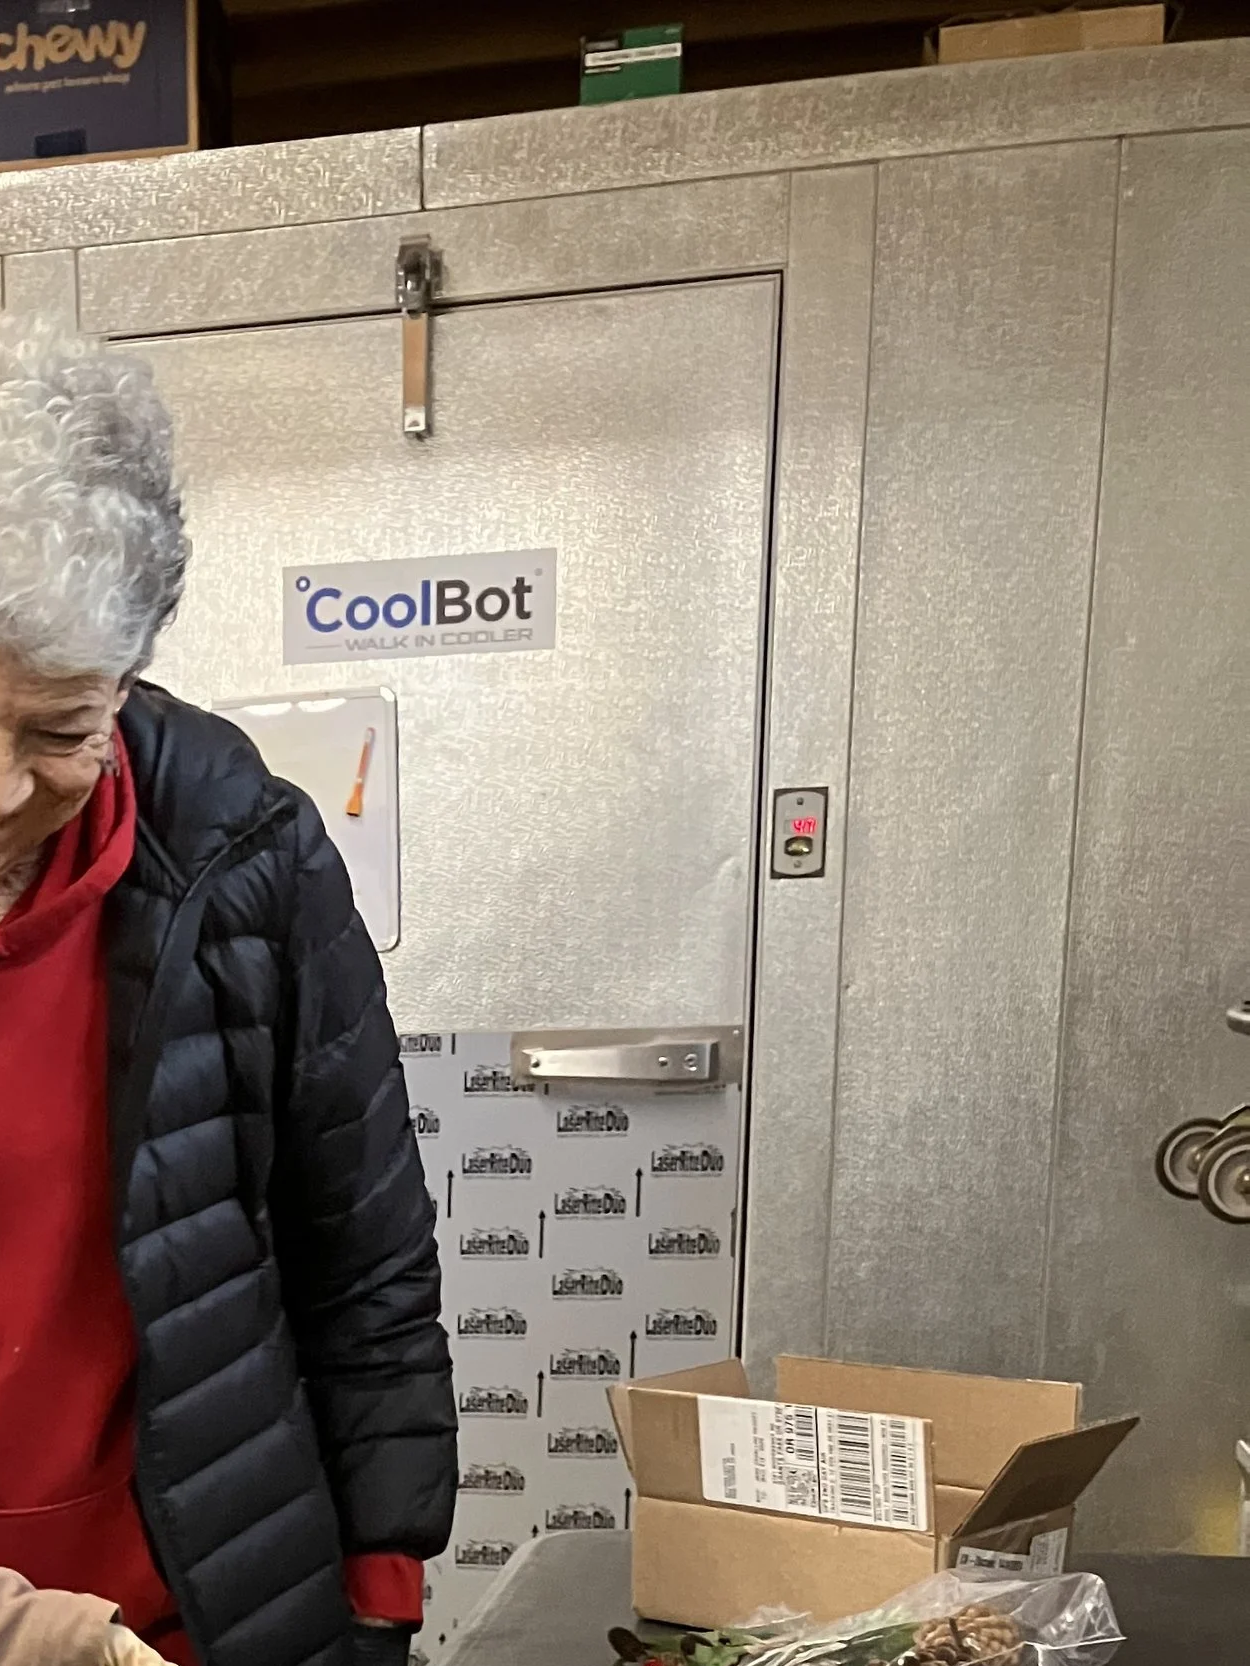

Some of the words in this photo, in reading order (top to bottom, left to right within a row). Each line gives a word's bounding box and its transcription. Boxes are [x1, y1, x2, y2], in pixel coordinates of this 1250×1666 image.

[345, 634, 409, 652] WALK
[415, 632, 435, 648] IN
[440, 628, 533, 646] COOLER
